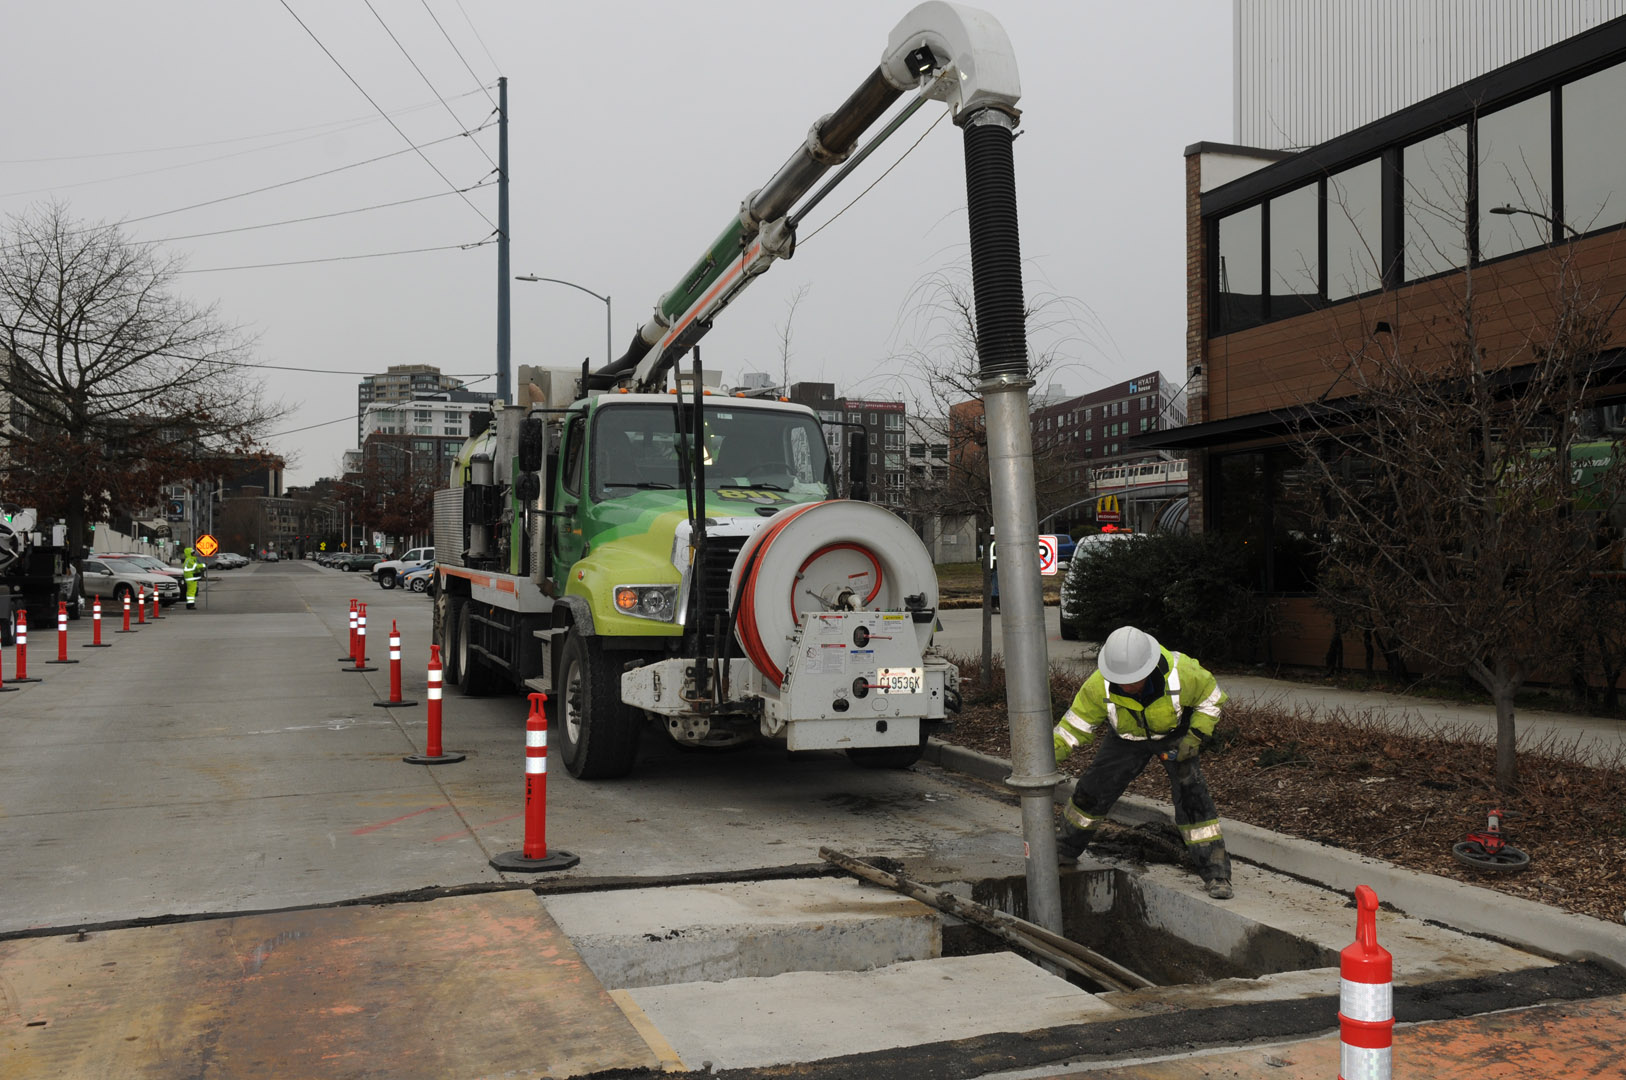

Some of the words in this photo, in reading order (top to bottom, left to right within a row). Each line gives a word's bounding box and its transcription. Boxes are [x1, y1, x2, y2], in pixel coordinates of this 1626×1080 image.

[1138, 376, 1155, 386] HYATT
[717, 489, 782, 501] 811
[199, 542, 215, 550] SLOW
[880, 676, 920, 690] C19536K
